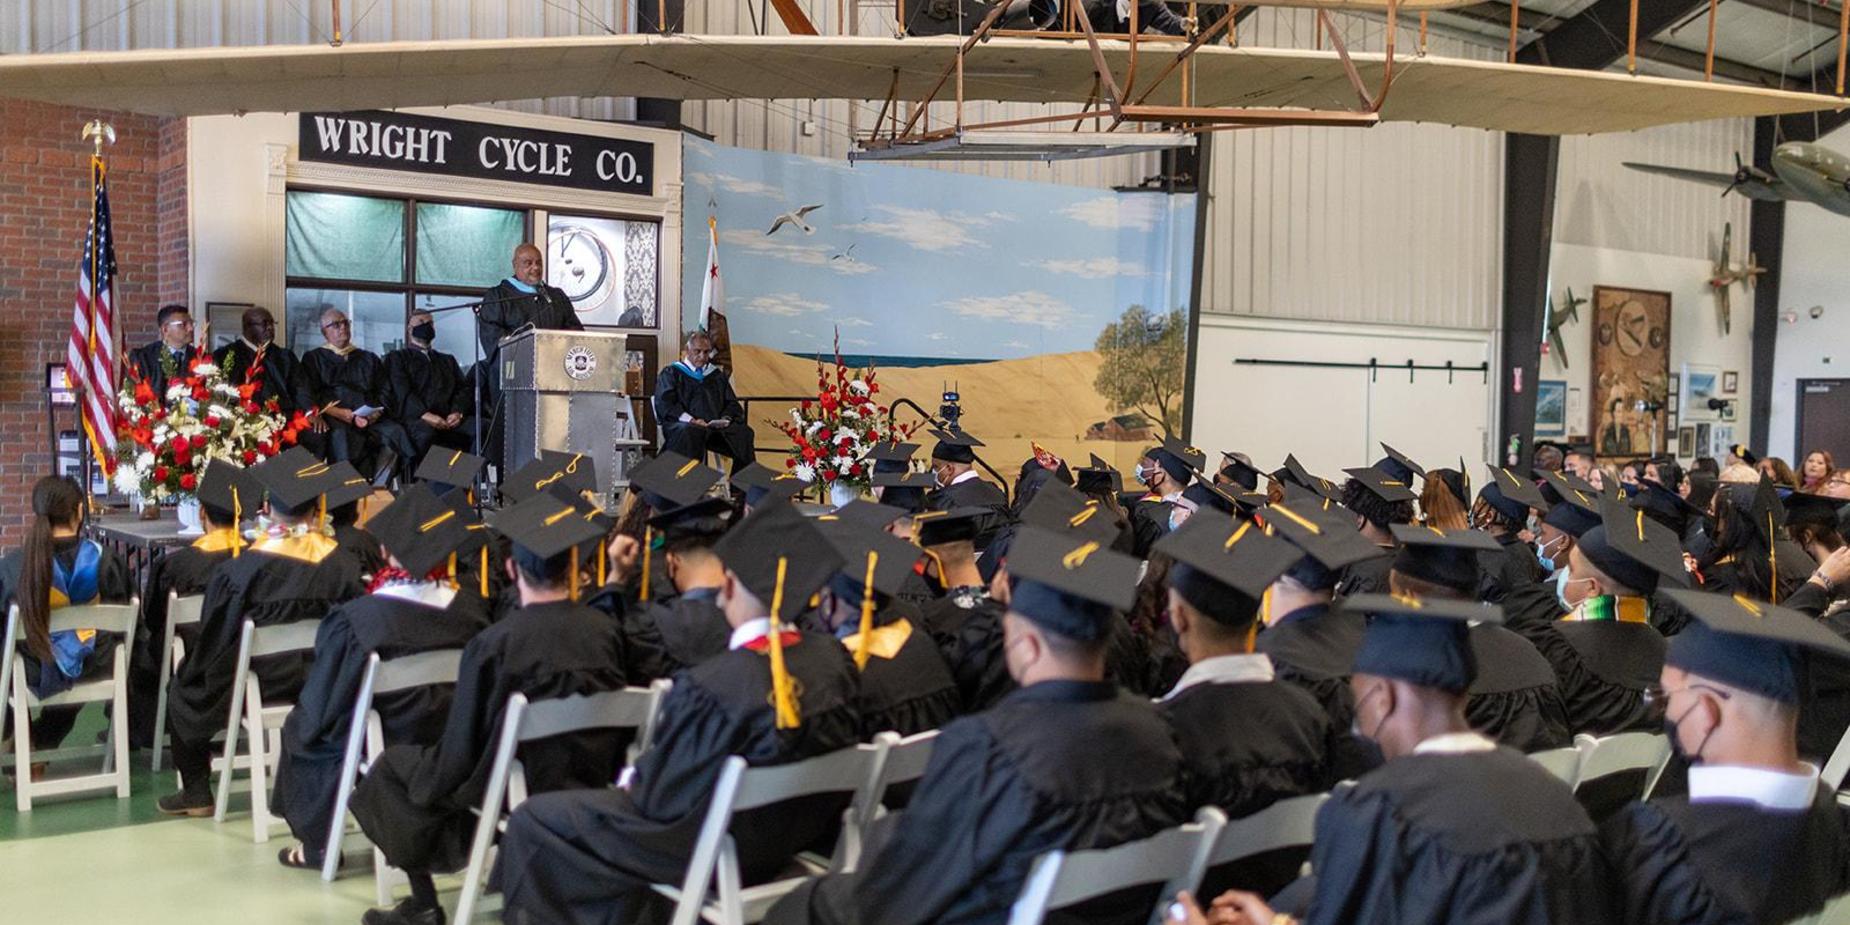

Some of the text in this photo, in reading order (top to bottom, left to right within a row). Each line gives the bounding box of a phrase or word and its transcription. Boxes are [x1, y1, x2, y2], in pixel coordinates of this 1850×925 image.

[314, 115, 643, 184] WRIGHT CYCLE CO.
